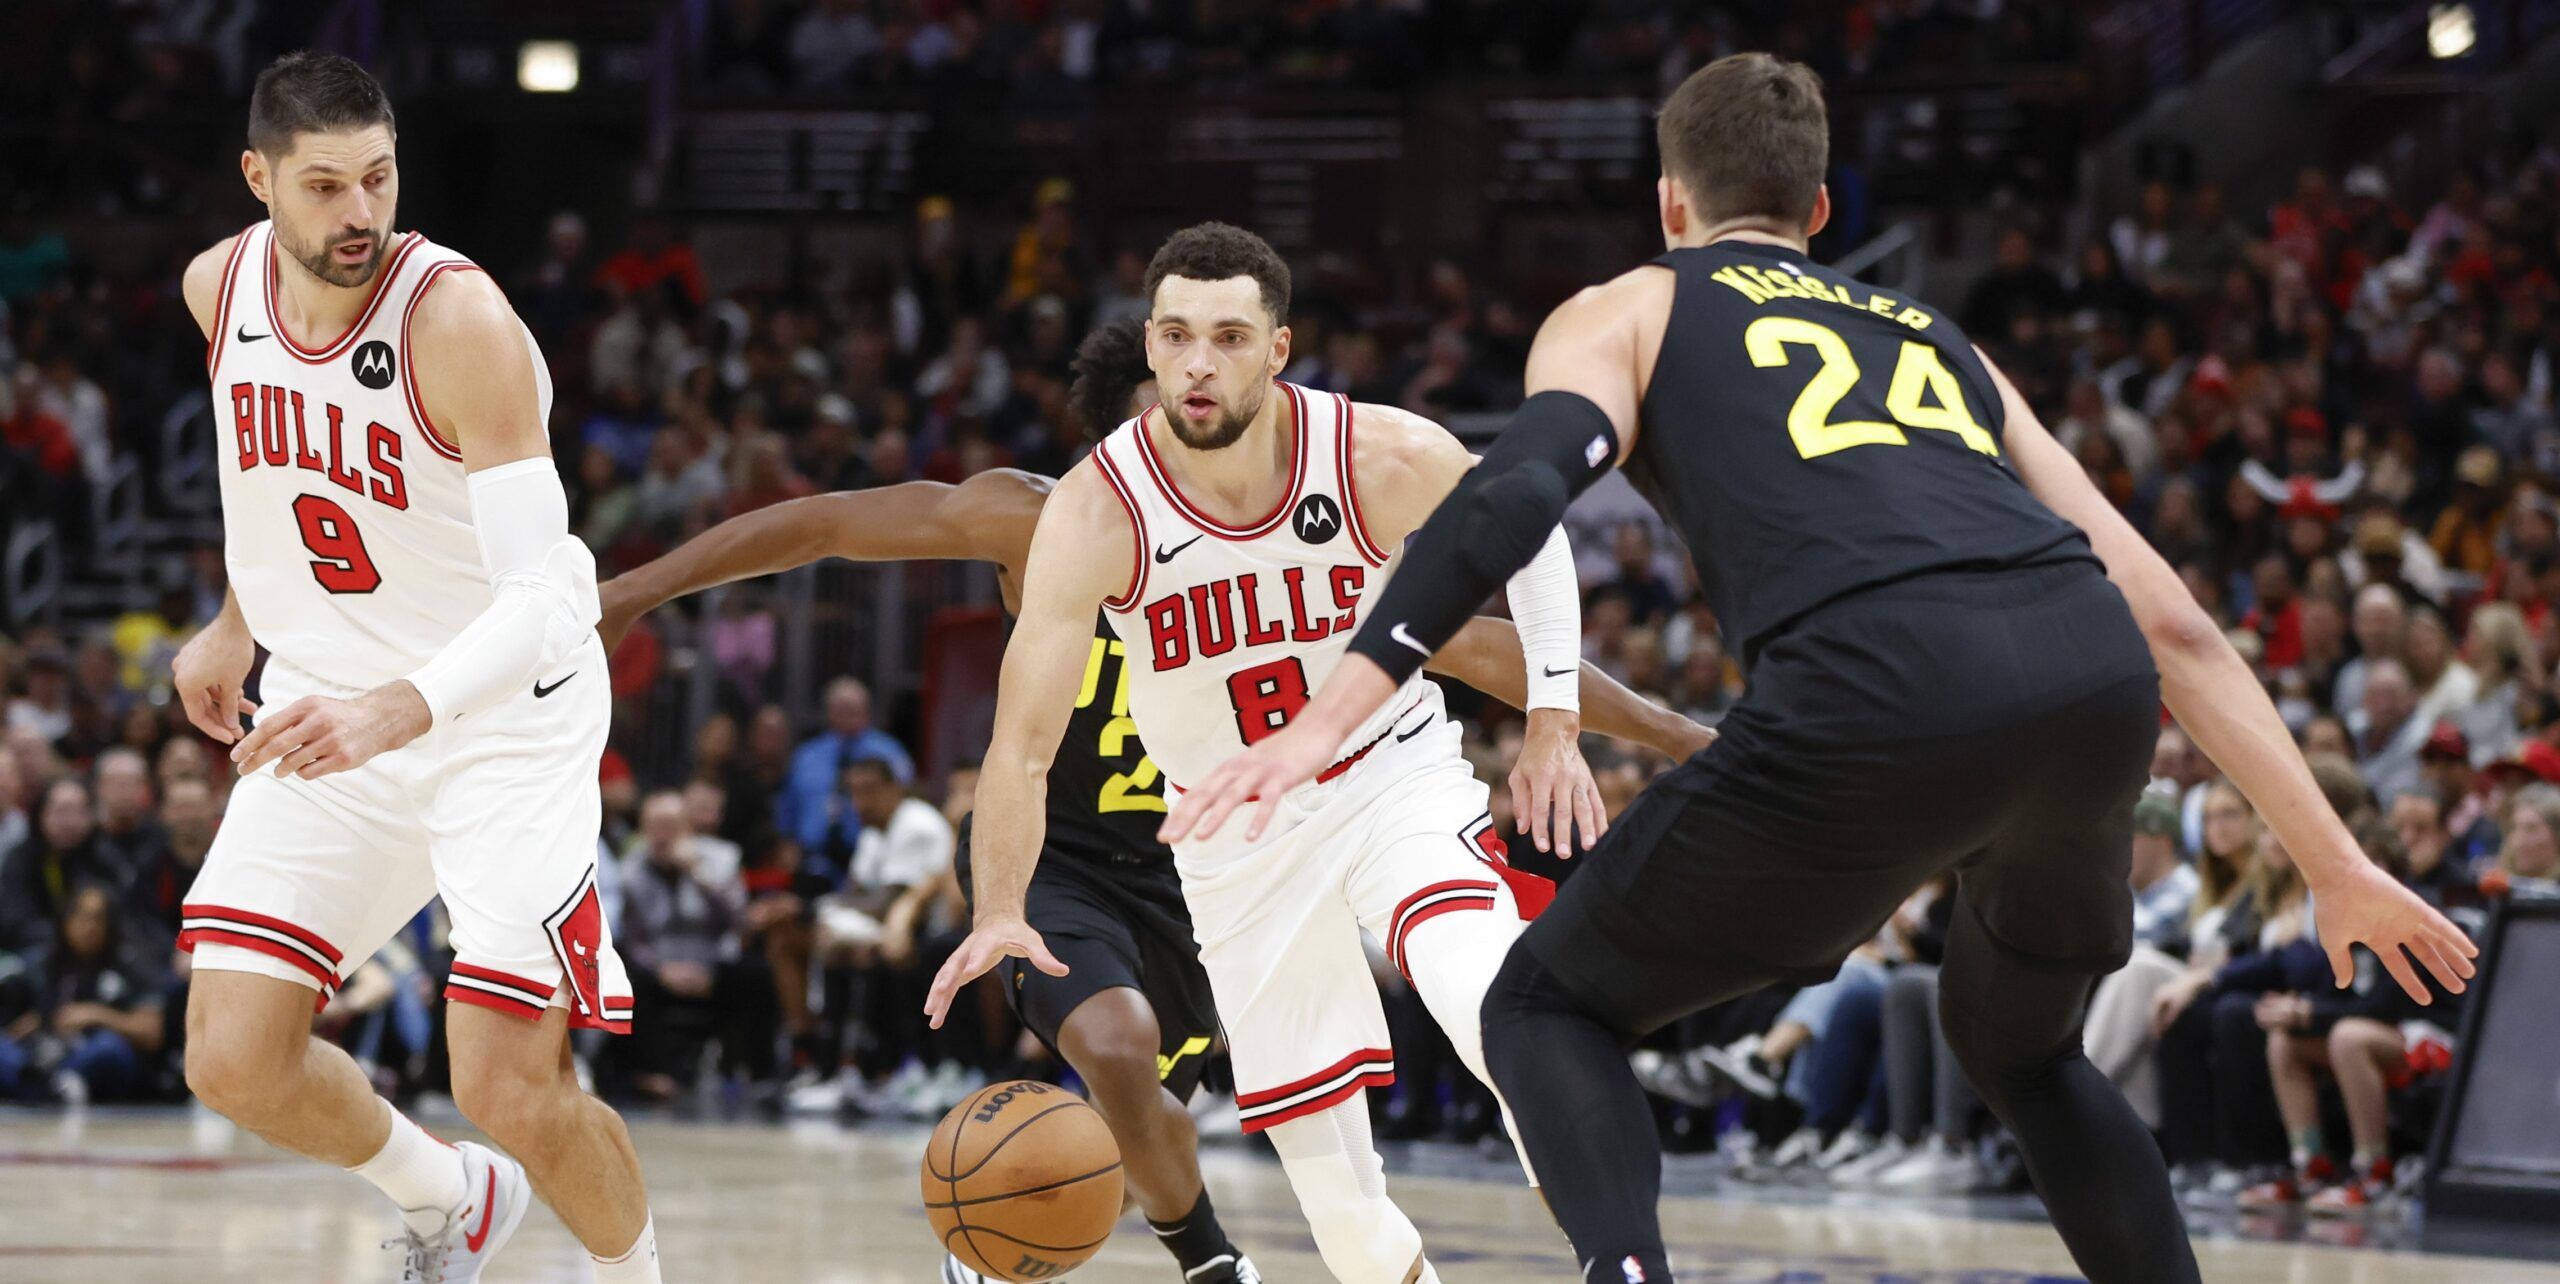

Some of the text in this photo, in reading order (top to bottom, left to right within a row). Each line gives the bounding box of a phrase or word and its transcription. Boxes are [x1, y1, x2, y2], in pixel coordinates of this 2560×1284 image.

[1710, 264, 1933, 331] KESSLER
[1744, 316, 1999, 458] 24
[231, 382, 409, 511] BULLS
[292, 493, 382, 594] 9
[1144, 565, 1364, 672] BULLS
[1226, 656, 1310, 747] 8
